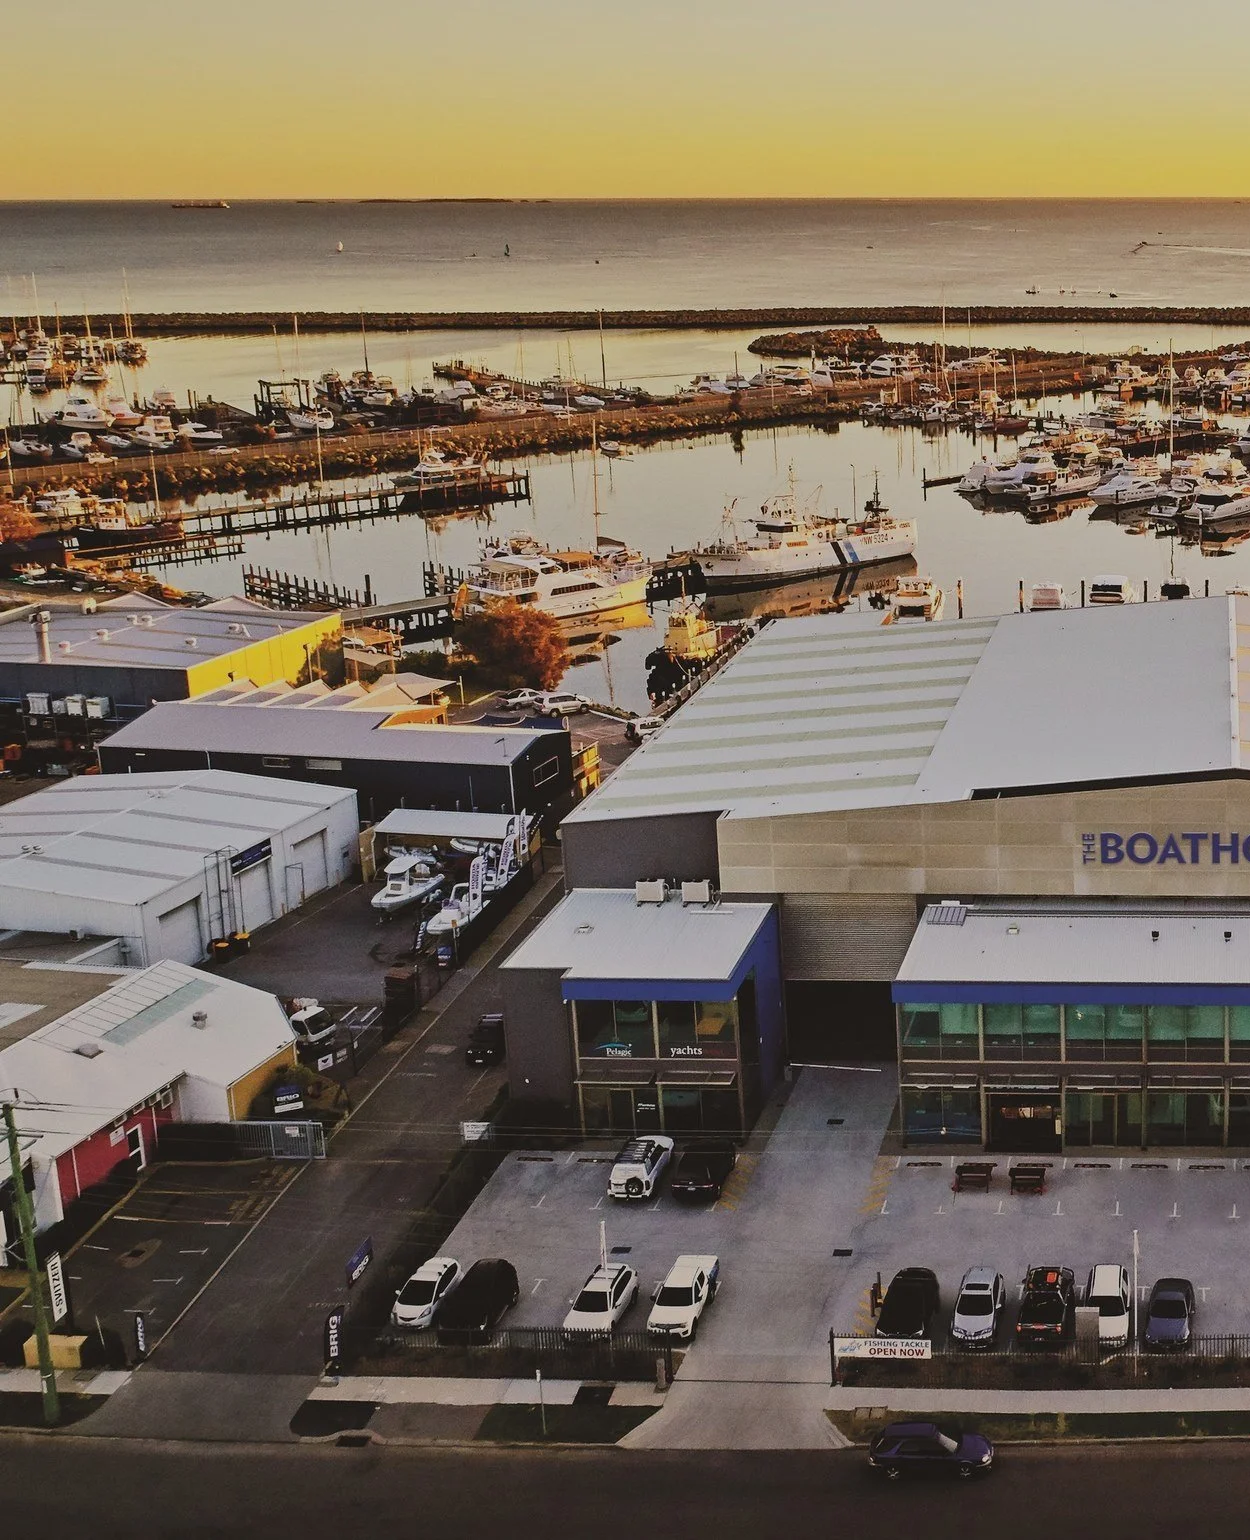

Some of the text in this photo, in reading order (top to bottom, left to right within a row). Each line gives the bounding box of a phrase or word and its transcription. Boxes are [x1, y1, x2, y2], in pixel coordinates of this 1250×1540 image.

[1082, 832, 1096, 865] THE
[606, 1047, 632, 1057] Pelagic
[670, 1045, 703, 1057] yachts
[50, 1261, 64, 1307] SVITZER
[329, 1315, 339, 1357] BRIG
[869, 1347, 925, 1356] OPEN NOW
